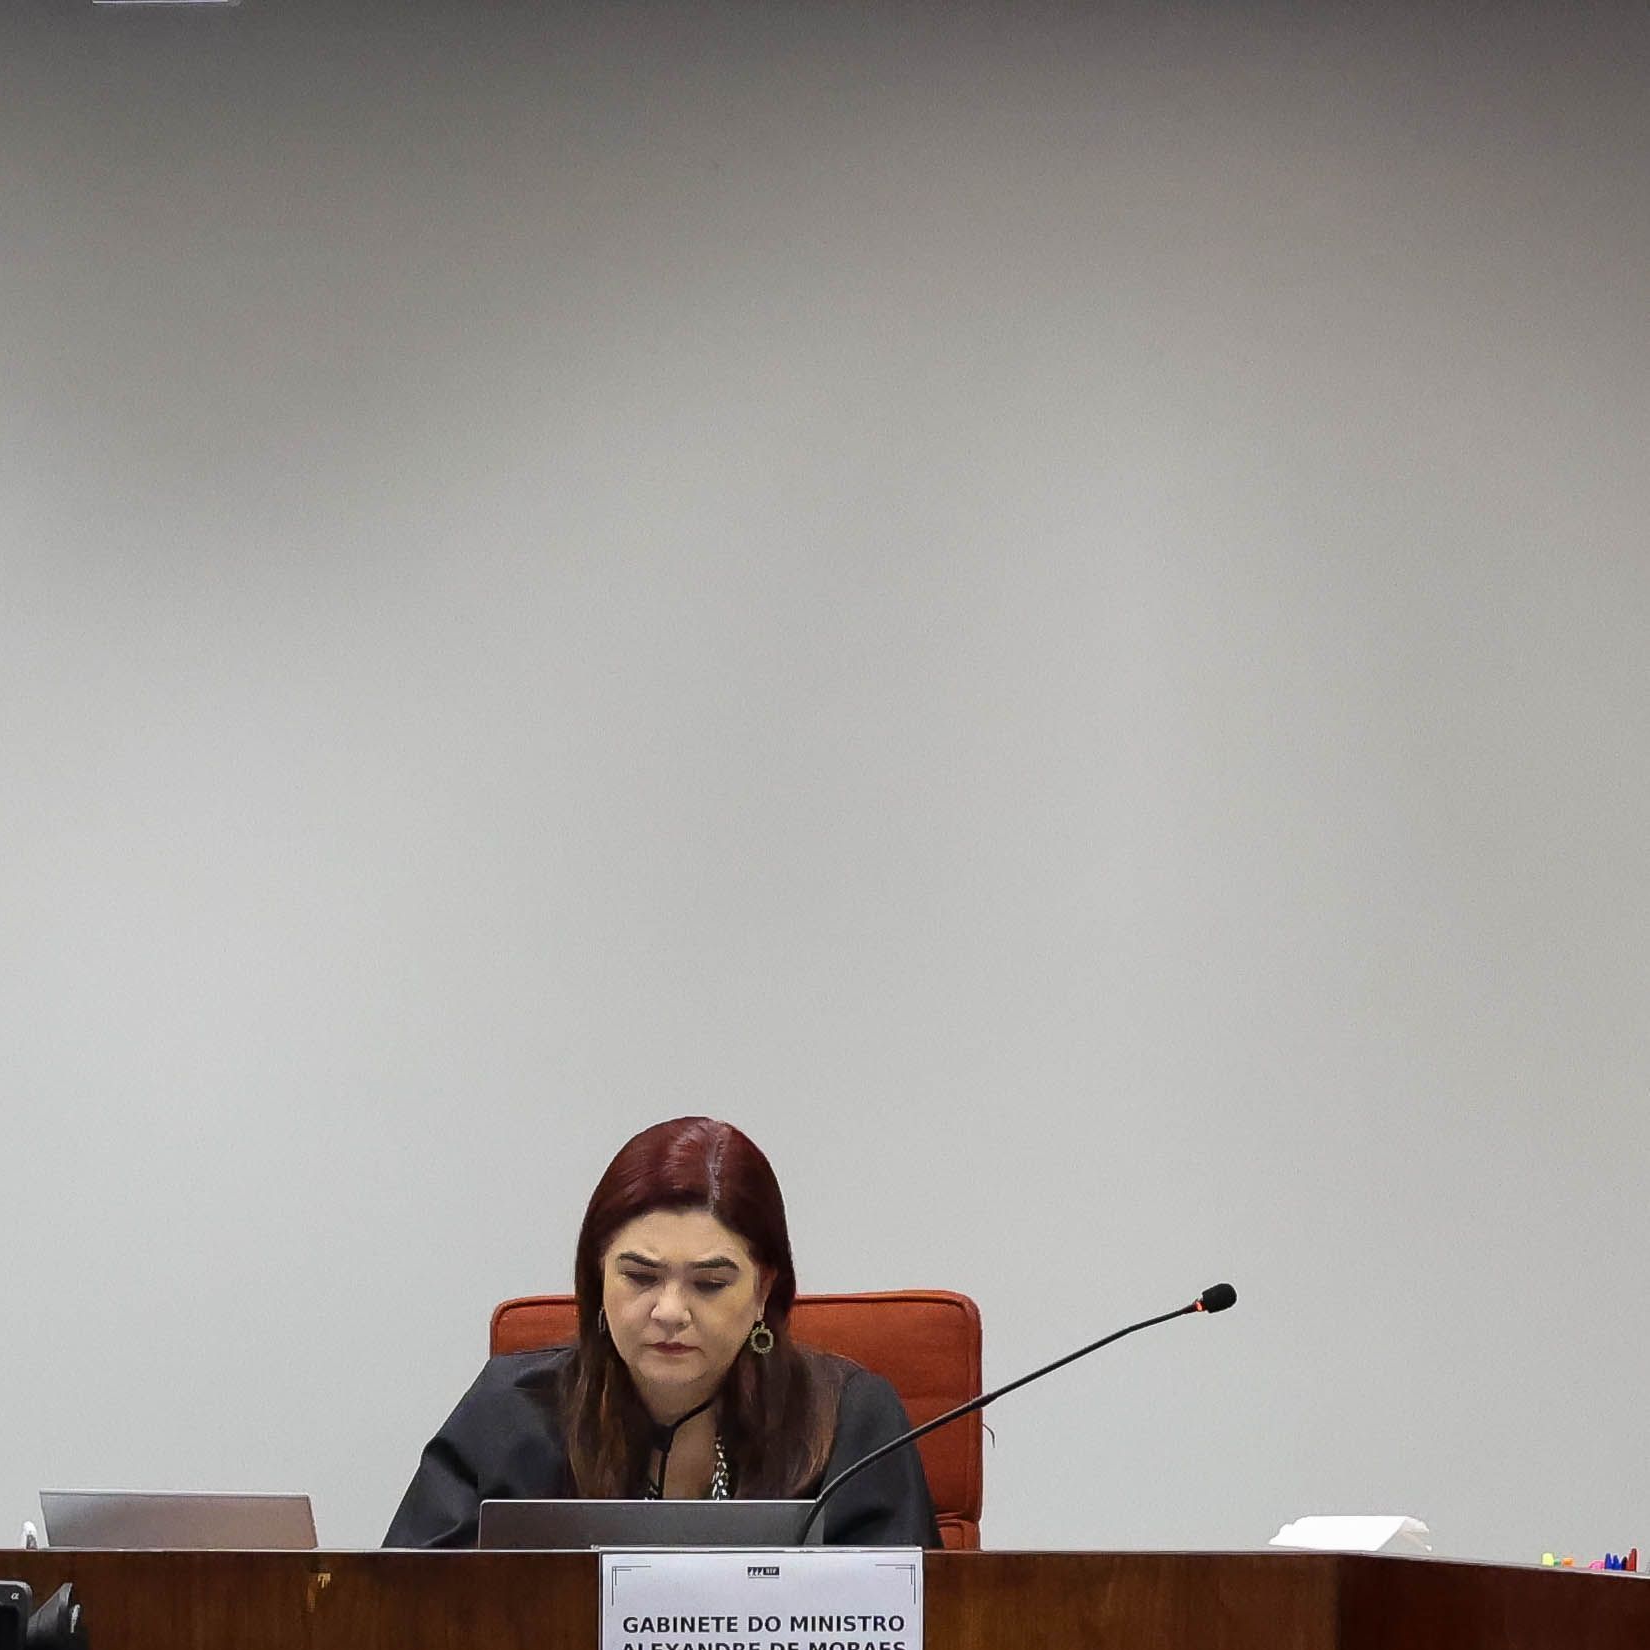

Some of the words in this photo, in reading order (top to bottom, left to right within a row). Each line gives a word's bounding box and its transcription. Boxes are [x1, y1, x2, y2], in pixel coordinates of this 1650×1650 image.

[622, 1615, 739, 1634] GABINETE
[747, 1615, 782, 1633] DO
[789, 1614, 905, 1632] MINISTRO
